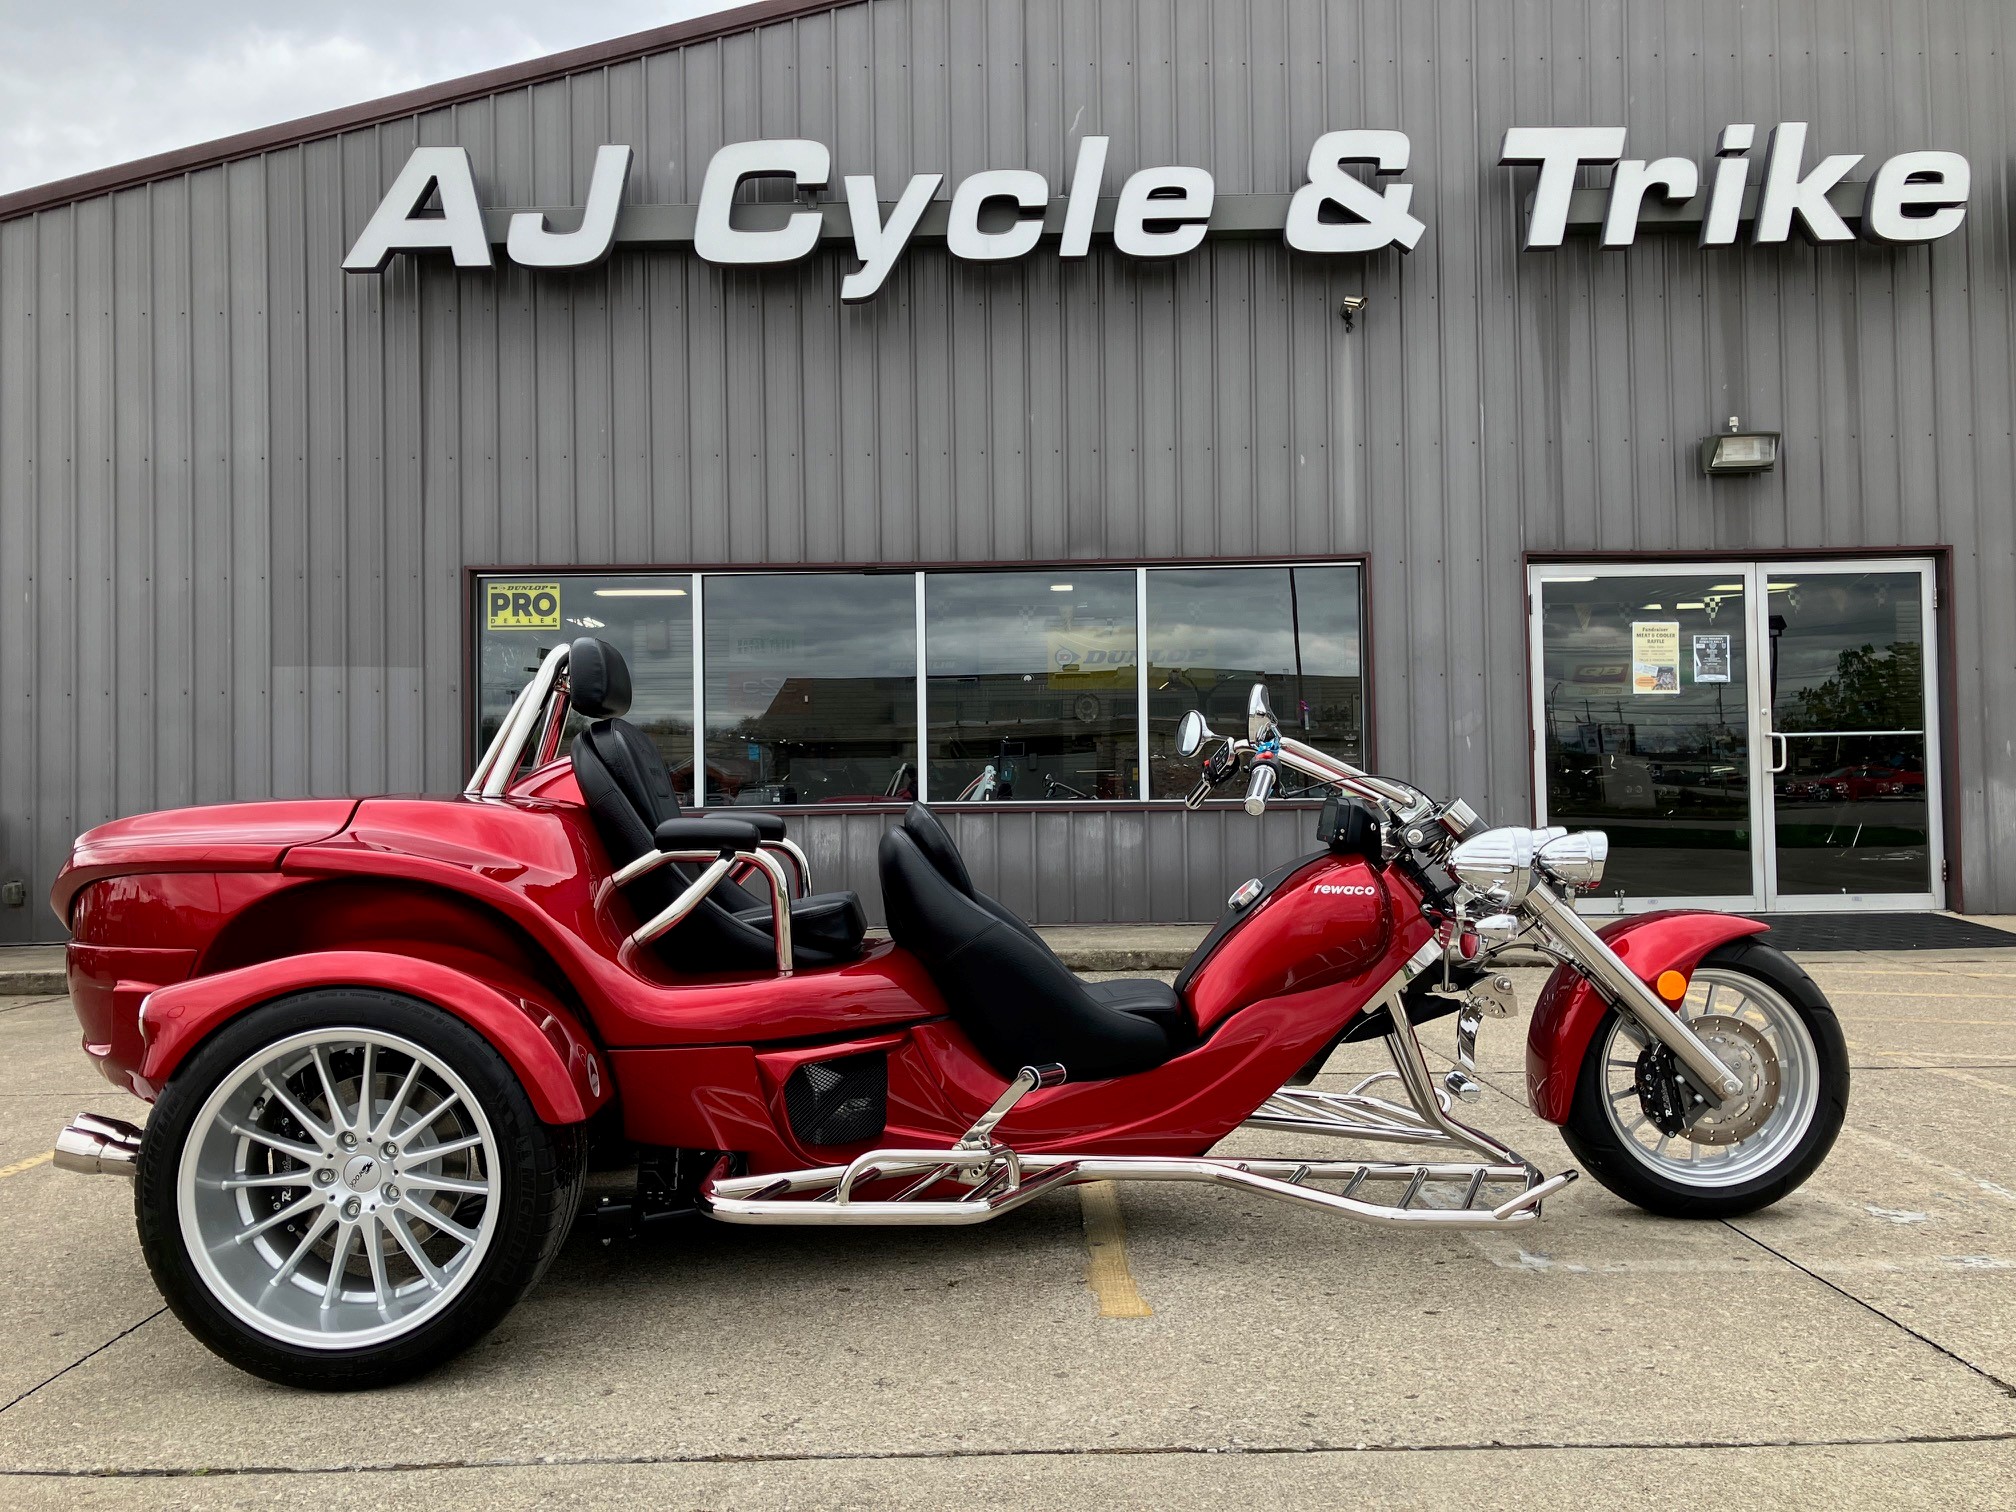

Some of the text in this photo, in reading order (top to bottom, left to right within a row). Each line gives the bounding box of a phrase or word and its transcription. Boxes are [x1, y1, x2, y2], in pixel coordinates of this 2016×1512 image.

[342, 120, 1972, 305] AJ Cycle & Trike
[491, 592, 557, 617] PRO
[1313, 884, 1375, 896] rewaco
